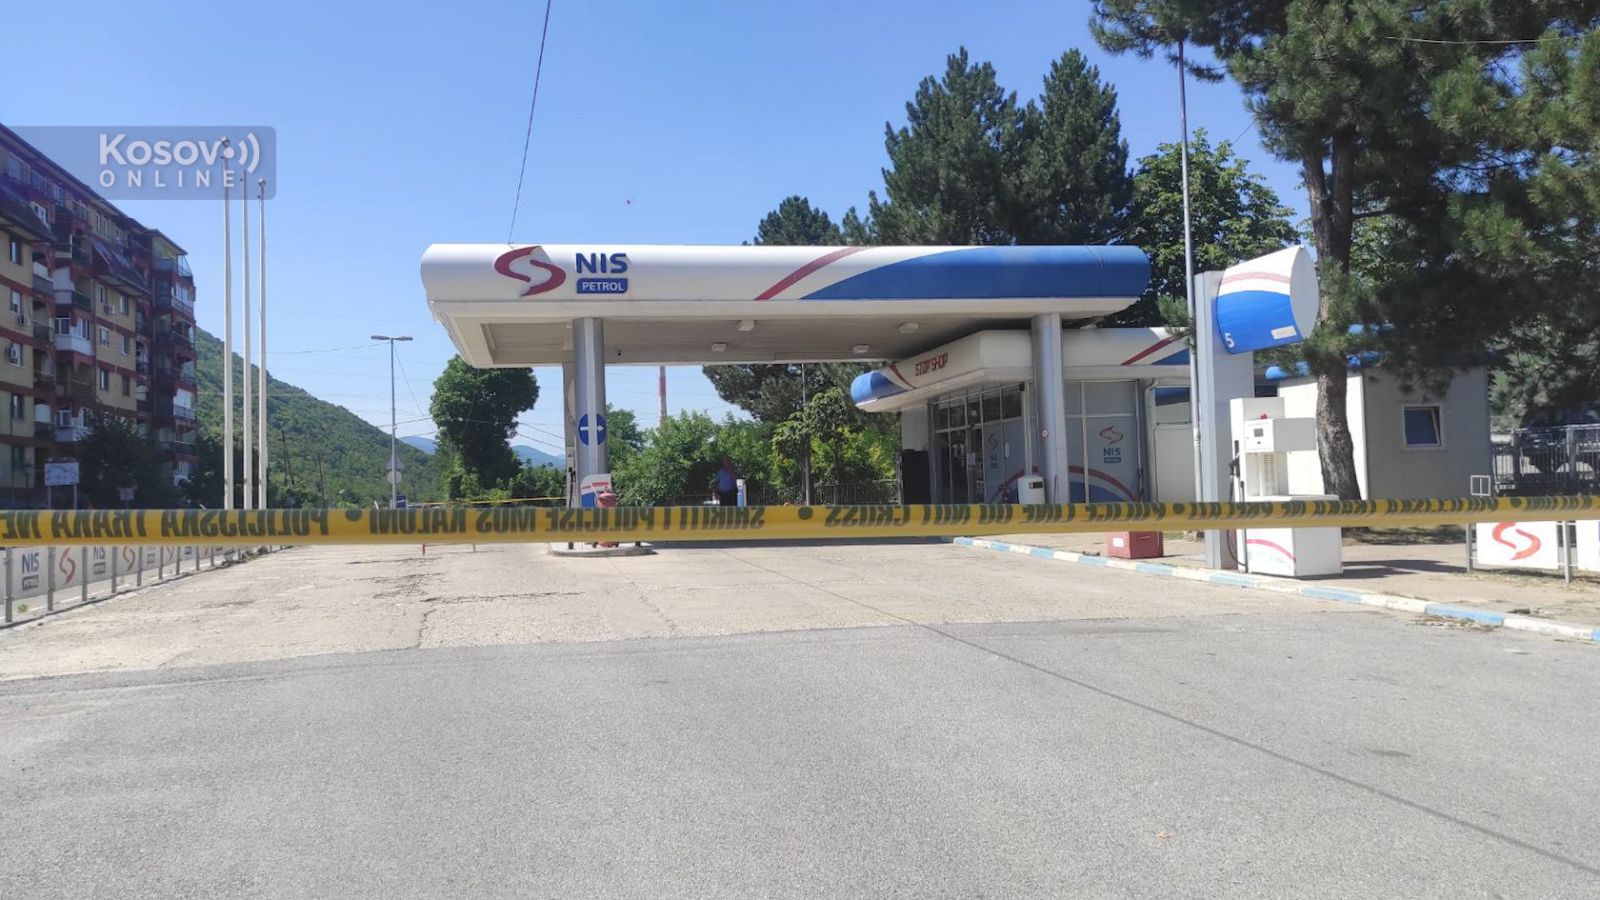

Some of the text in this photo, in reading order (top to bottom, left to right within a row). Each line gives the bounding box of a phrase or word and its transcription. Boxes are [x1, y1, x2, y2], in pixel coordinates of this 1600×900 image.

[576, 253, 628, 274] NIS
[582, 281, 624, 292] PETROL
[1225, 333, 1235, 348] 5
[22, 552, 39, 574] NIS
